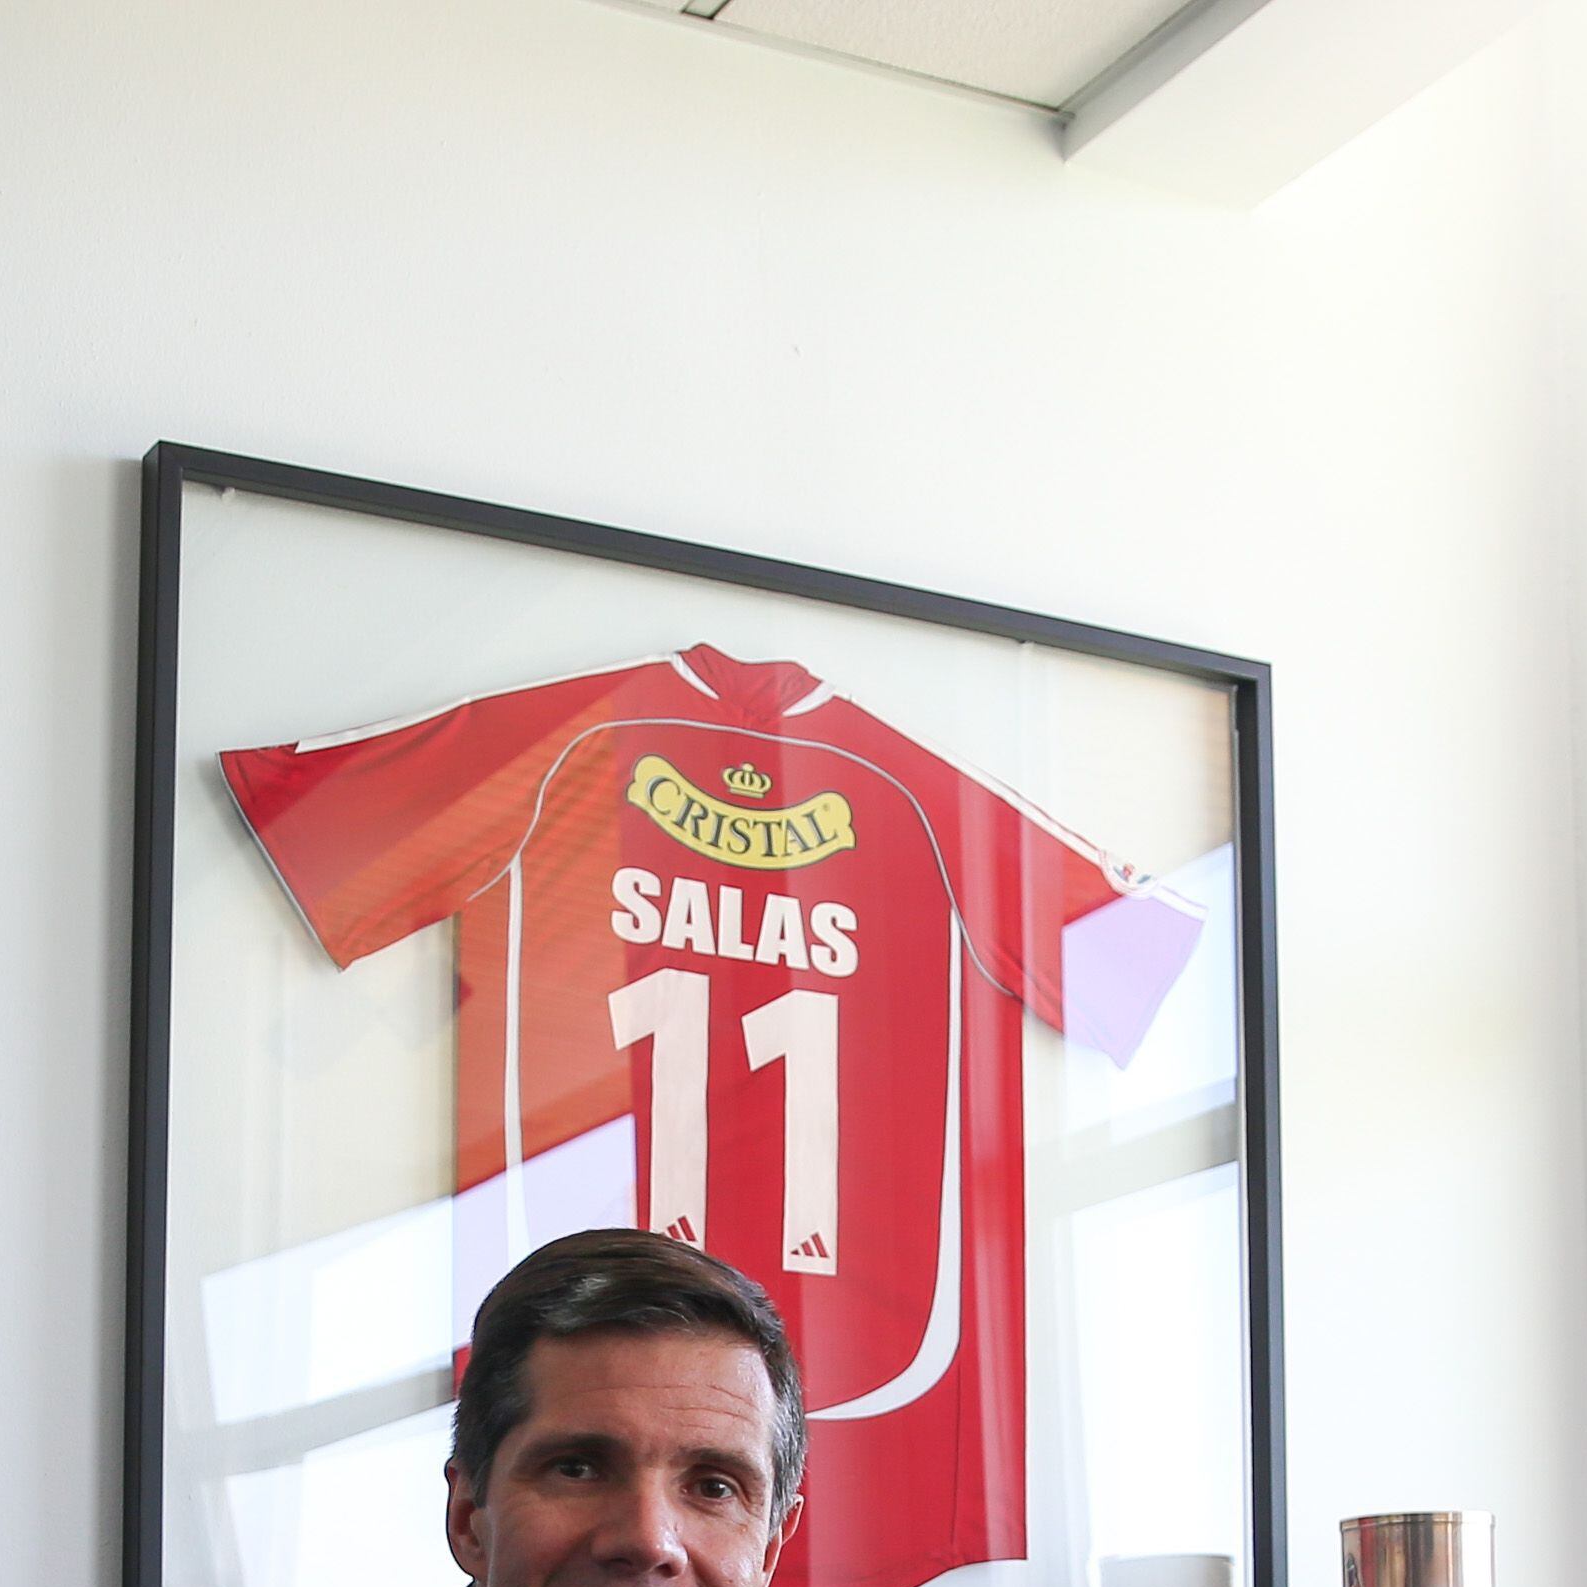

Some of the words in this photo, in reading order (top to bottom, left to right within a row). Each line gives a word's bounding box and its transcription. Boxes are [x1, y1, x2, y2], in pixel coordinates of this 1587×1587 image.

[645, 774, 840, 859] CRISTAL
[609, 864, 860, 979] SALAS
[607, 967, 840, 1277] 11
